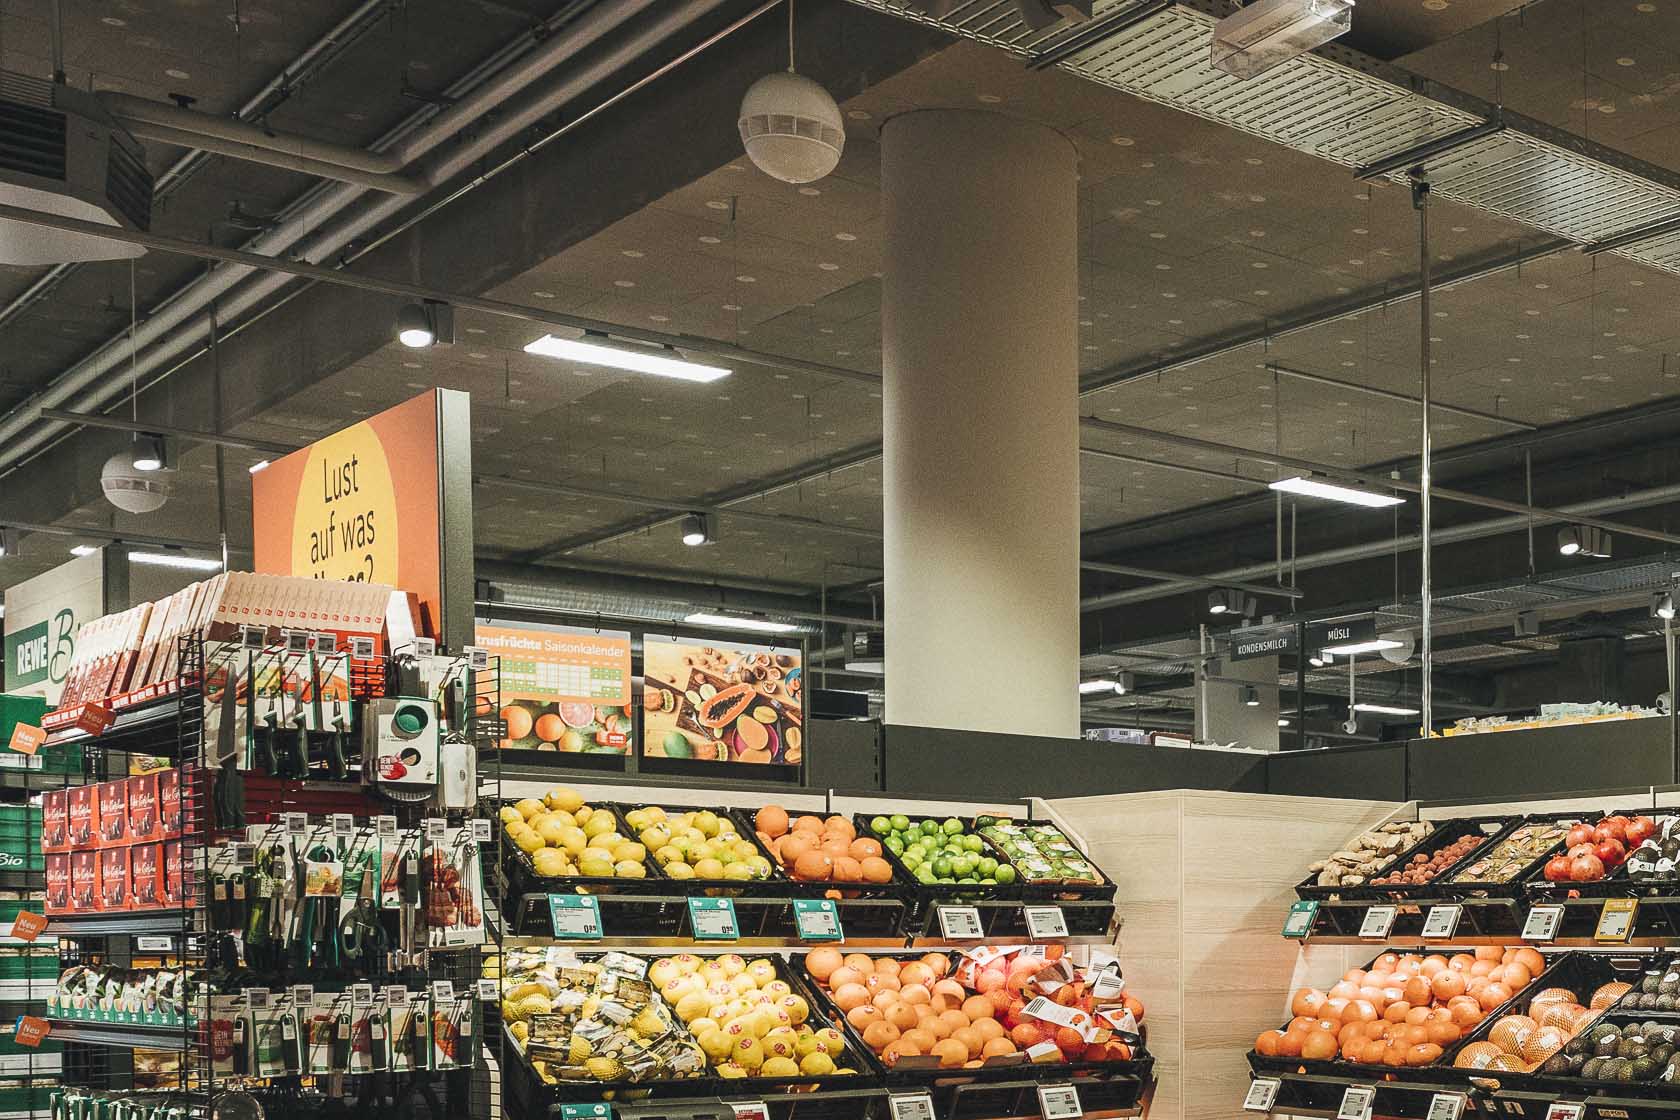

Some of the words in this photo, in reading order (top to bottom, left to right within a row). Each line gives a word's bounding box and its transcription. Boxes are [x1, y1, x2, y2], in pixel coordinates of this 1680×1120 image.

[323, 454, 360, 504] Lust
[310, 510, 336, 564] auf
[341, 510, 376, 553] was
[1327, 627, 1350, 641] MÜSLI
[476, 635, 542, 650] trusfrüchte
[544, 639, 625, 657] Saisonkalender
[1237, 638, 1287, 655] KONDENSMILCH
[17, 635, 48, 676] REWE
[84, 711, 104, 723] Neu
[18, 731, 36, 742] Neu
[0, 853, 23, 867] Bio
[19, 918, 37, 930] Neu
[23, 1023, 40, 1034] Neu
[565, 1107, 577, 1115] Bio
